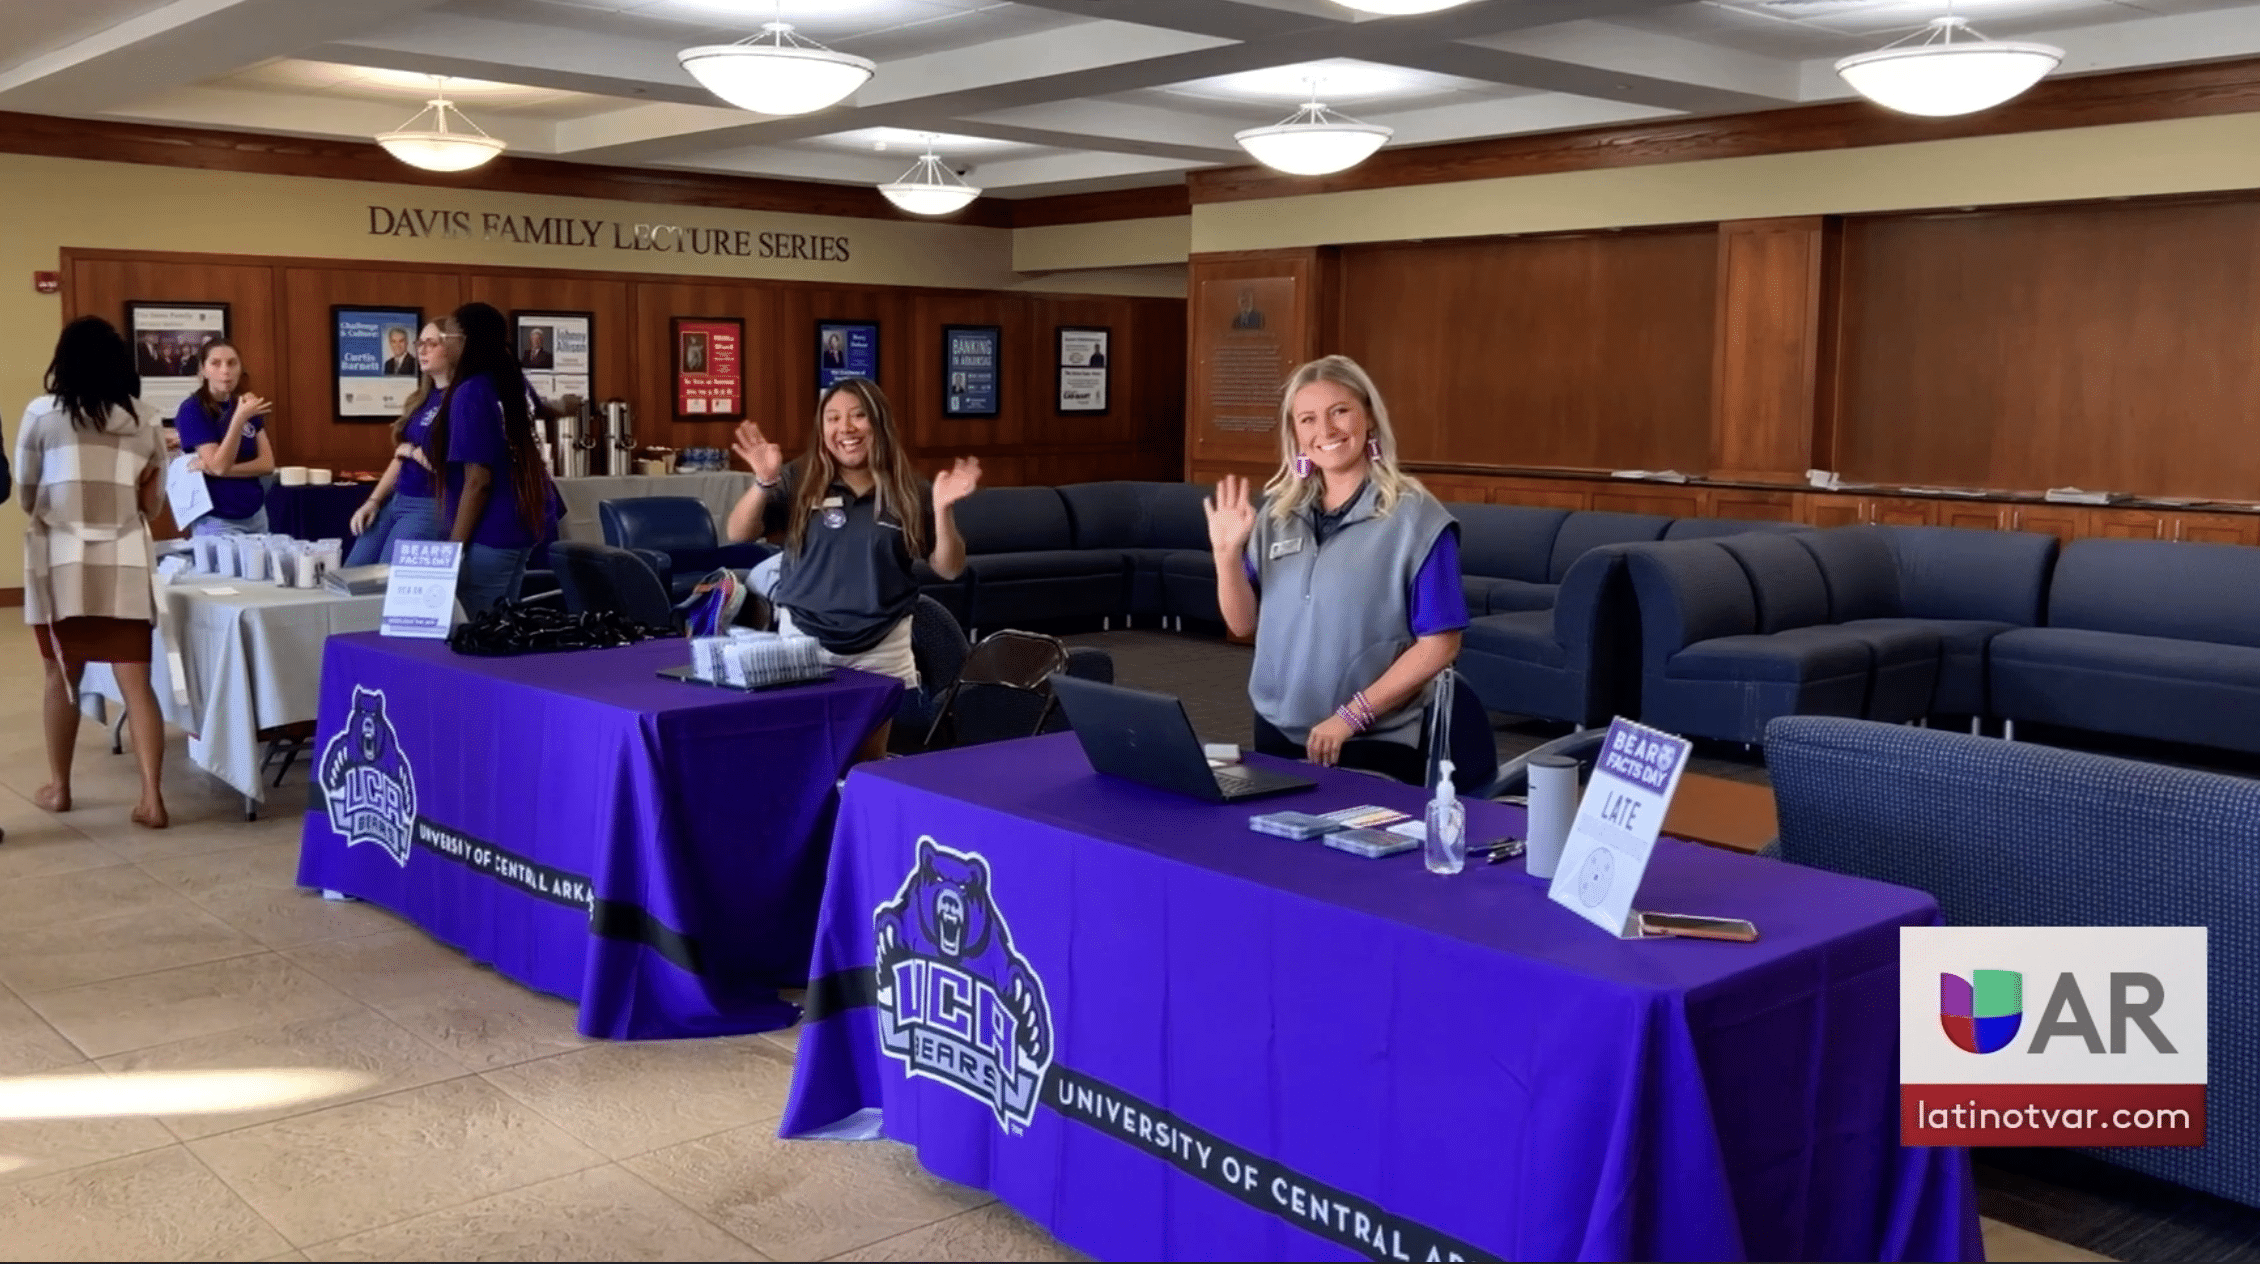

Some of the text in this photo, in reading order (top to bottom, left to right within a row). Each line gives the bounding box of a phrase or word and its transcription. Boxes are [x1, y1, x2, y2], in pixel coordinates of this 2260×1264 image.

[368, 205, 850, 262] DAVIS FAMILY LECTURE SERIES
[952, 339, 992, 354] BANKING
[1612, 730, 1660, 764] BEAR
[1606, 751, 1668, 788] FACTS DAY
[1601, 790, 1642, 831] LATE
[473, 846, 492, 868] OF
[914, 1033, 997, 1093] EARS
[1058, 1078, 1212, 1170] UNIVERSITY
[1221, 1156, 1259, 1192] OF
[1271, 1176, 1410, 1262] CENTRAL
